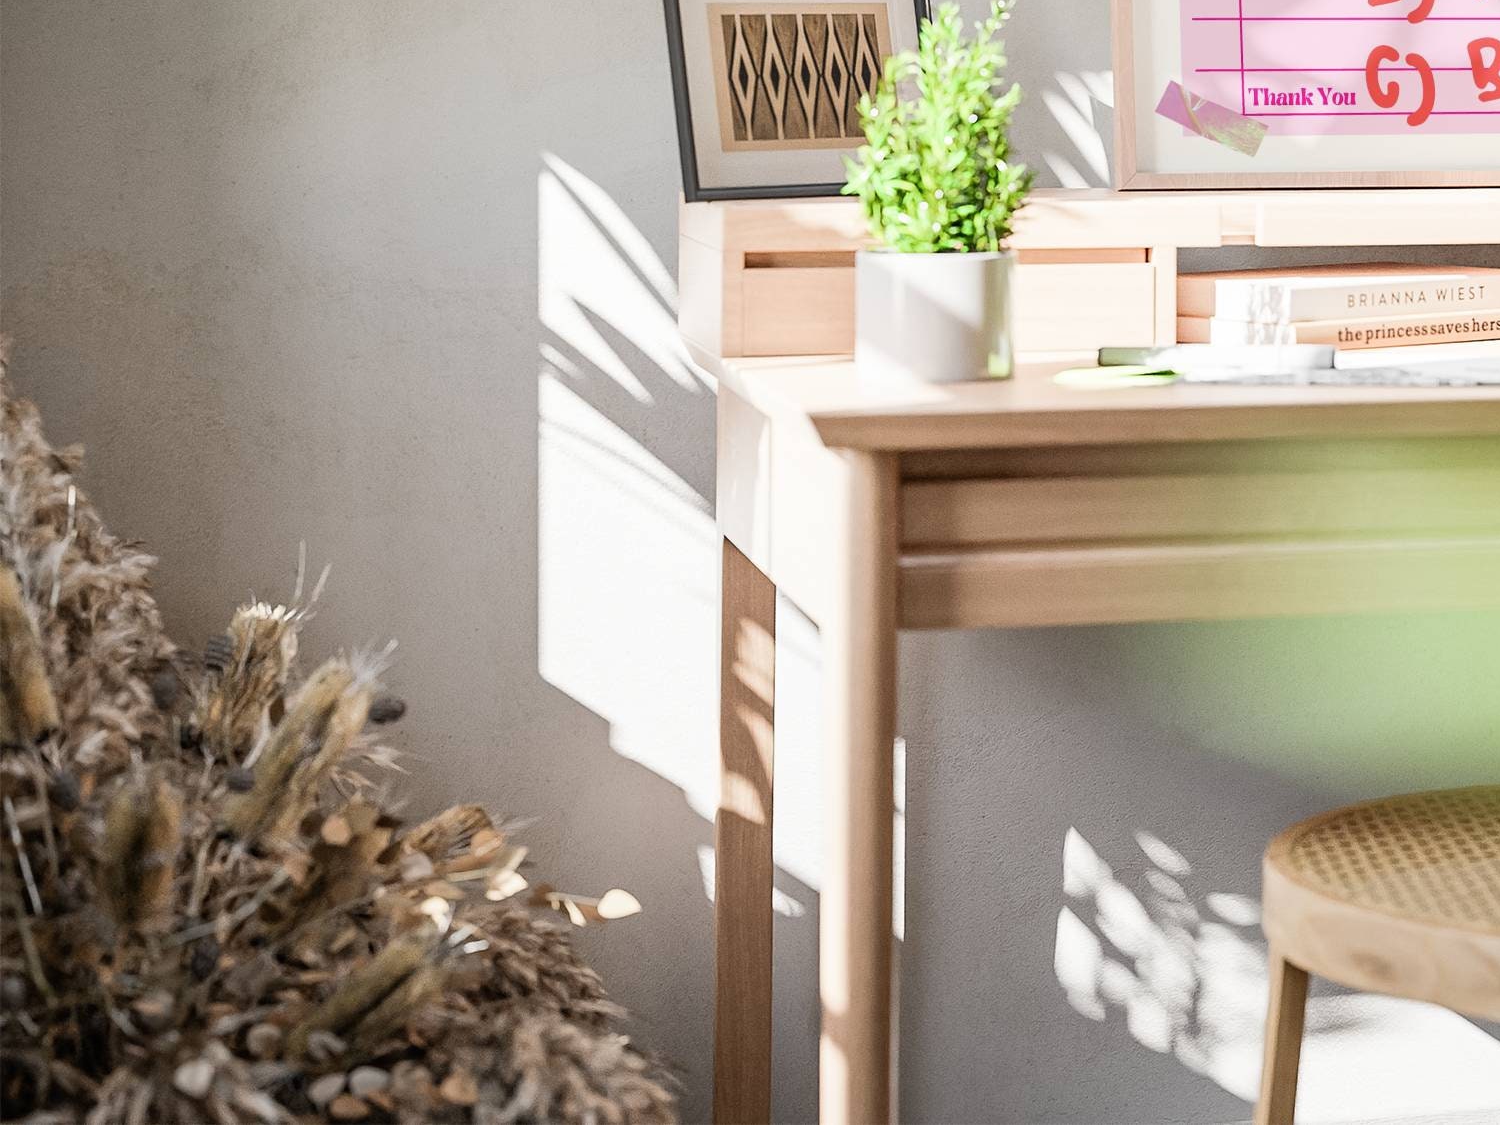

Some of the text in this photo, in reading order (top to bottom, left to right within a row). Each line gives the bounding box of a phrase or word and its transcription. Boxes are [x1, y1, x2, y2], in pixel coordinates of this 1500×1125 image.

[1248, 86, 1357, 107] Thank You
[1364, 44, 1436, 127] C)
[1346, 284, 1486, 309] BRIANNA WIEST
[1337, 326, 1363, 343] the
[1365, 322, 1429, 344] princess
[1430, 321, 1470, 336] saves
